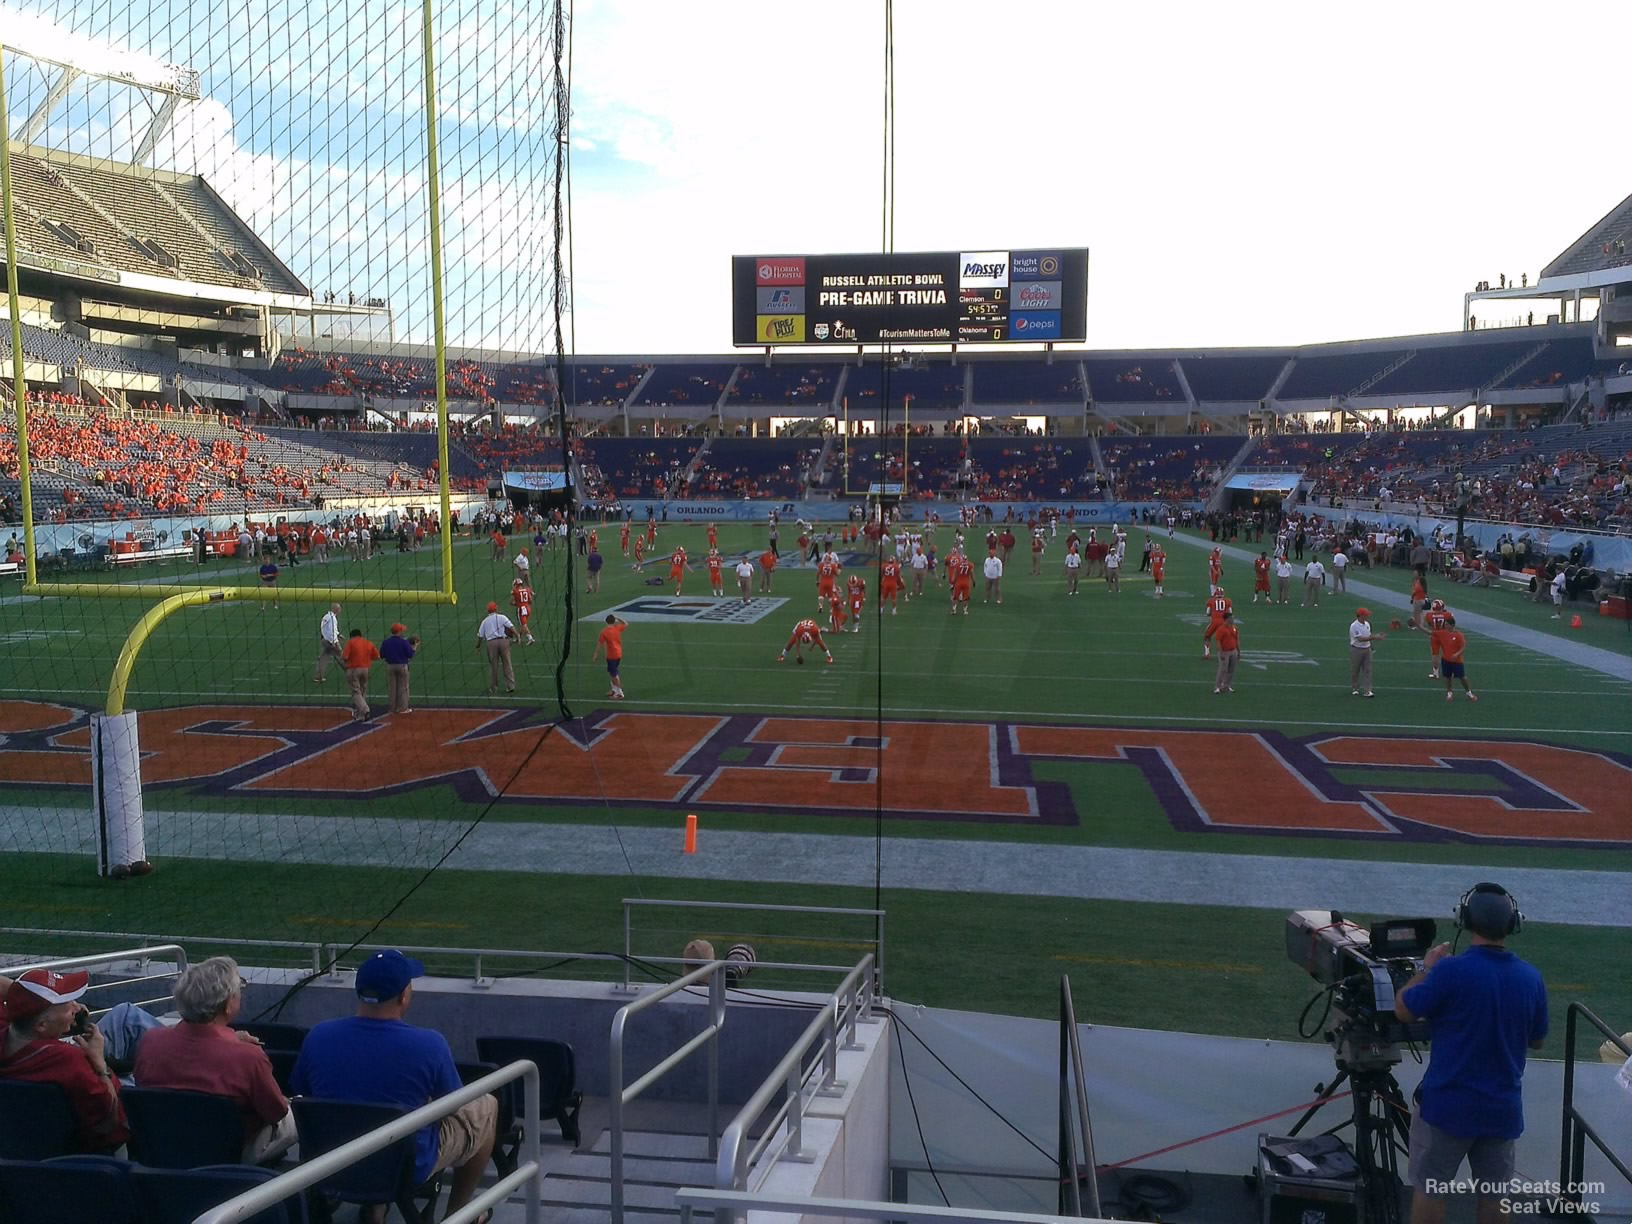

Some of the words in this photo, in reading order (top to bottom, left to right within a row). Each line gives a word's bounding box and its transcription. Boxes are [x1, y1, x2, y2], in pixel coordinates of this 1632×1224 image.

[1013, 258, 1037, 266] bright
[773, 271, 802, 279] HOSPITAL
[963, 263, 1006, 279] MASSEY
[823, 275, 866, 287] RUSSELL
[867, 275, 913, 286] ATHLETIC
[914, 274, 945, 285] BOWL
[820, 290, 896, 306] PRE-GAME
[897, 290, 947, 305] TRIVIA
[958, 295, 985, 303] Clemson
[1029, 320, 1055, 329] pepsi
[879, 328, 951, 338] #TourismMattersToMe
[958, 326, 988, 334] Oklahoma
[885, 567, 895, 577] 54
[959, 564, 969, 575] 77
[519, 591, 529, 603] 13
[1215, 599, 1226, 612] 10
[1432, 618, 1445, 629] 17
